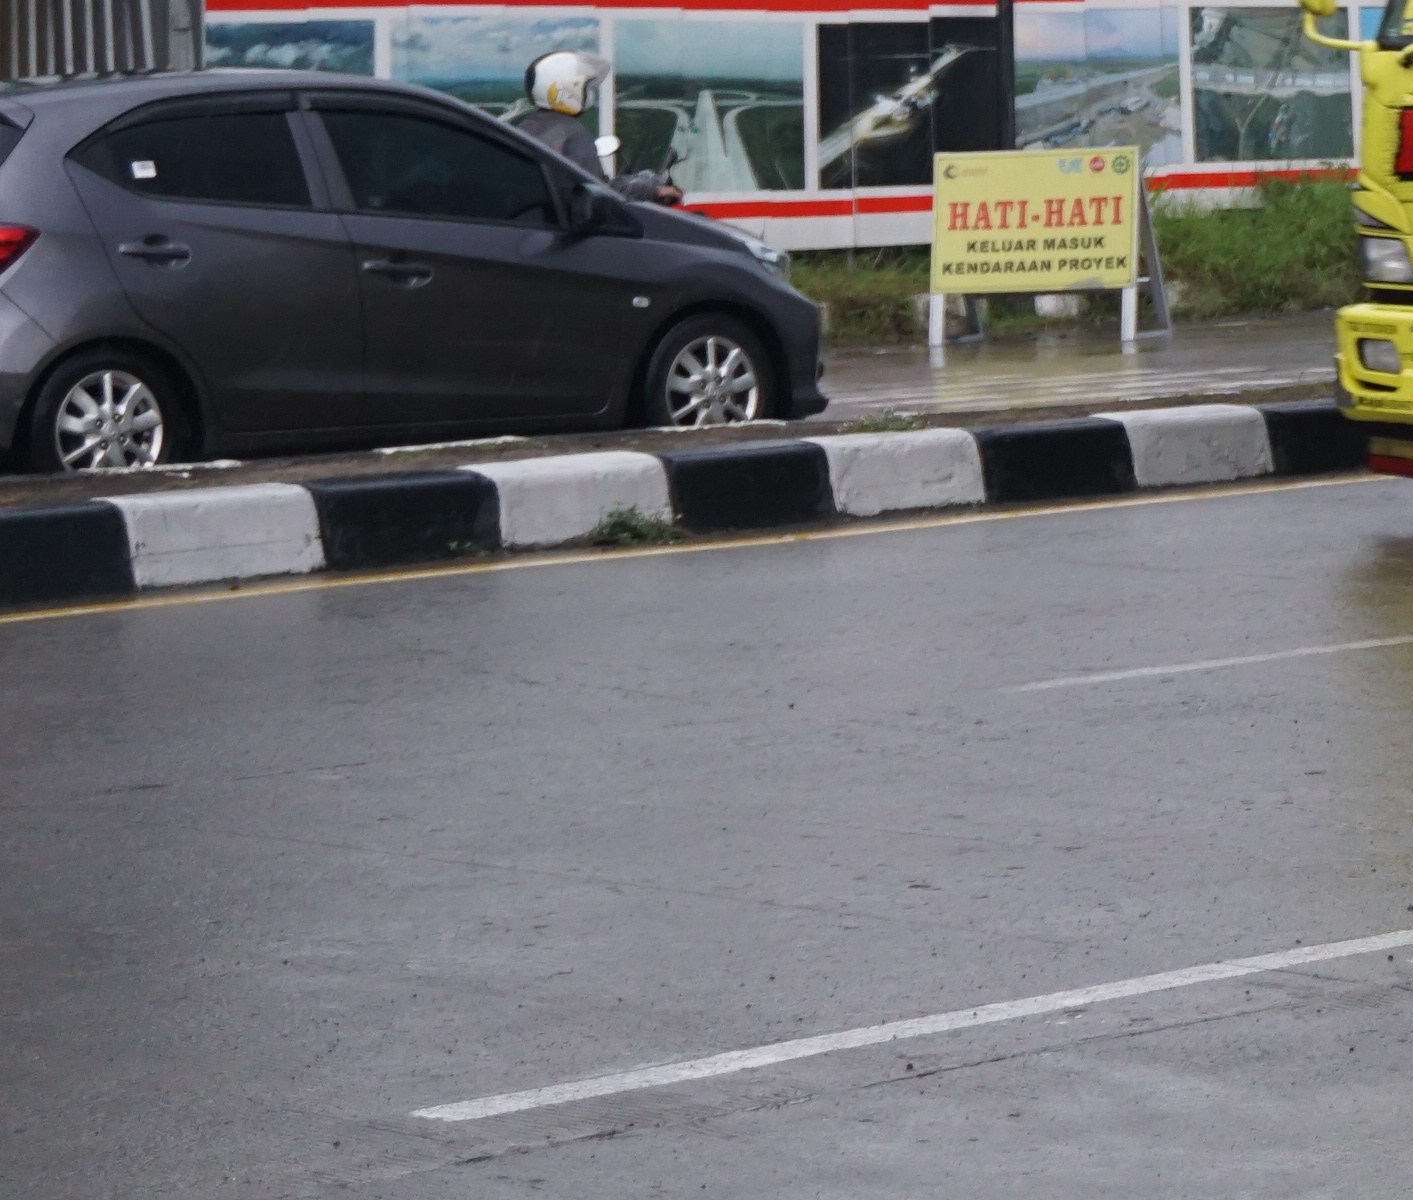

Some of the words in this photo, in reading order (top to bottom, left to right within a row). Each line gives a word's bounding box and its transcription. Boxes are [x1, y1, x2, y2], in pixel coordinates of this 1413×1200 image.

[947, 195, 1124, 231] HATI-HATI
[966, 239, 1037, 254] KELUAR
[1043, 236, 1105, 250] MASUK
[942, 257, 1051, 276] KENDARAAN
[1058, 255, 1128, 272] PROYEK
